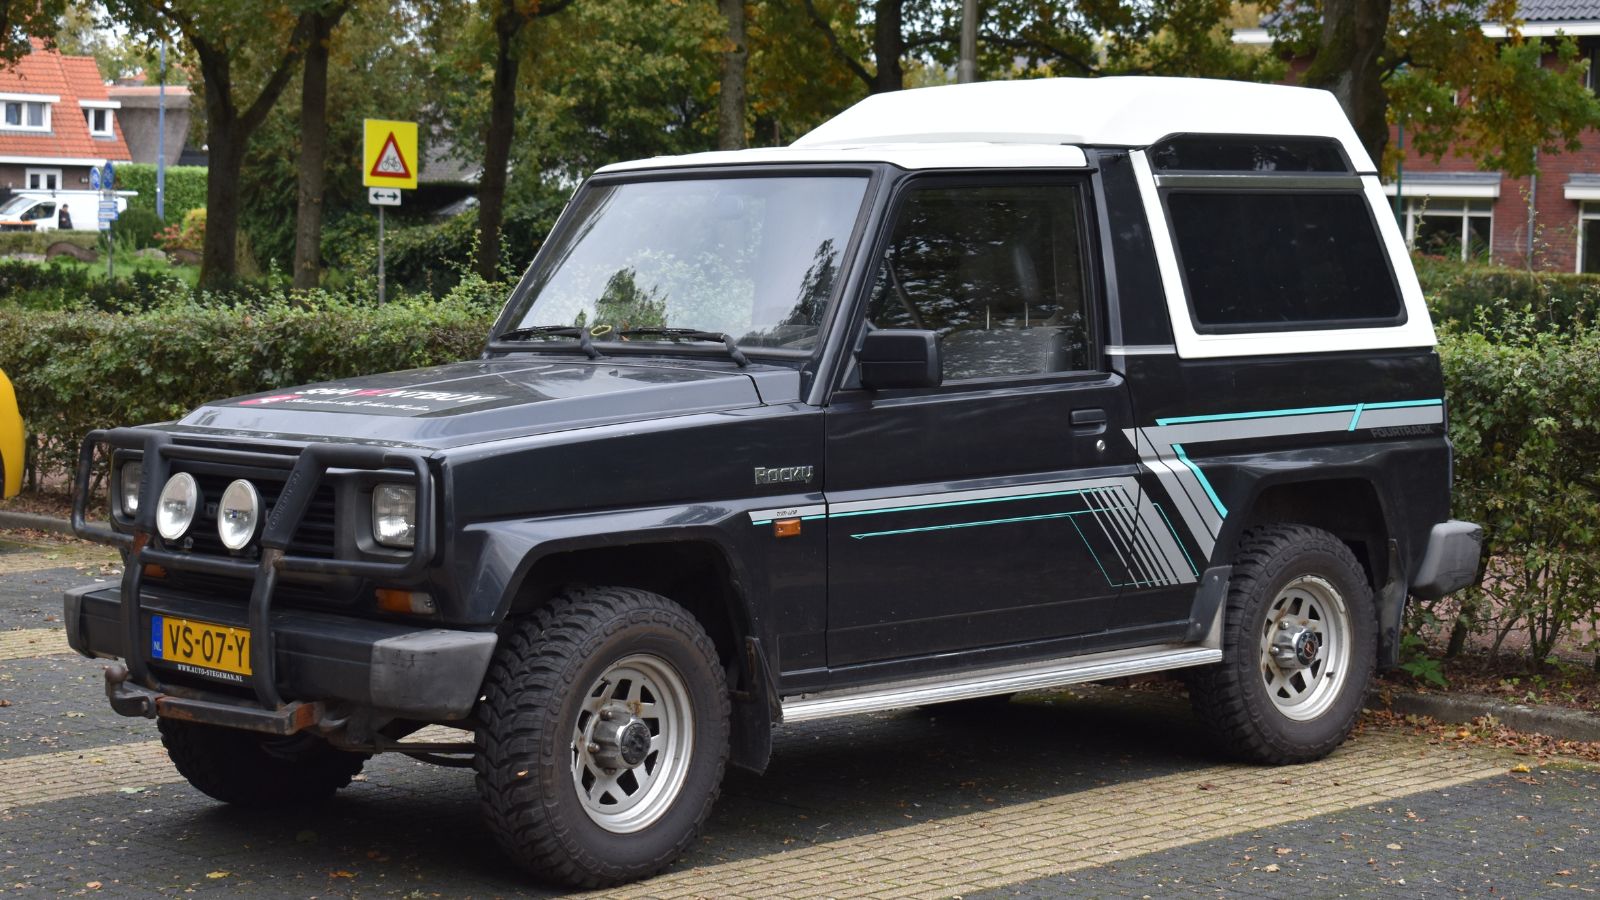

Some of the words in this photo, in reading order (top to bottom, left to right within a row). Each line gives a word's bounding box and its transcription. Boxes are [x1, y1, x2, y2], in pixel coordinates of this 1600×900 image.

[1370, 425, 1434, 438] FOURTRACK
[153, 641, 162, 651] NL
[169, 624, 252, 668] VS-07-Y
[177, 664, 244, 682] WWW.AUTO-STEGEMAN.NL
